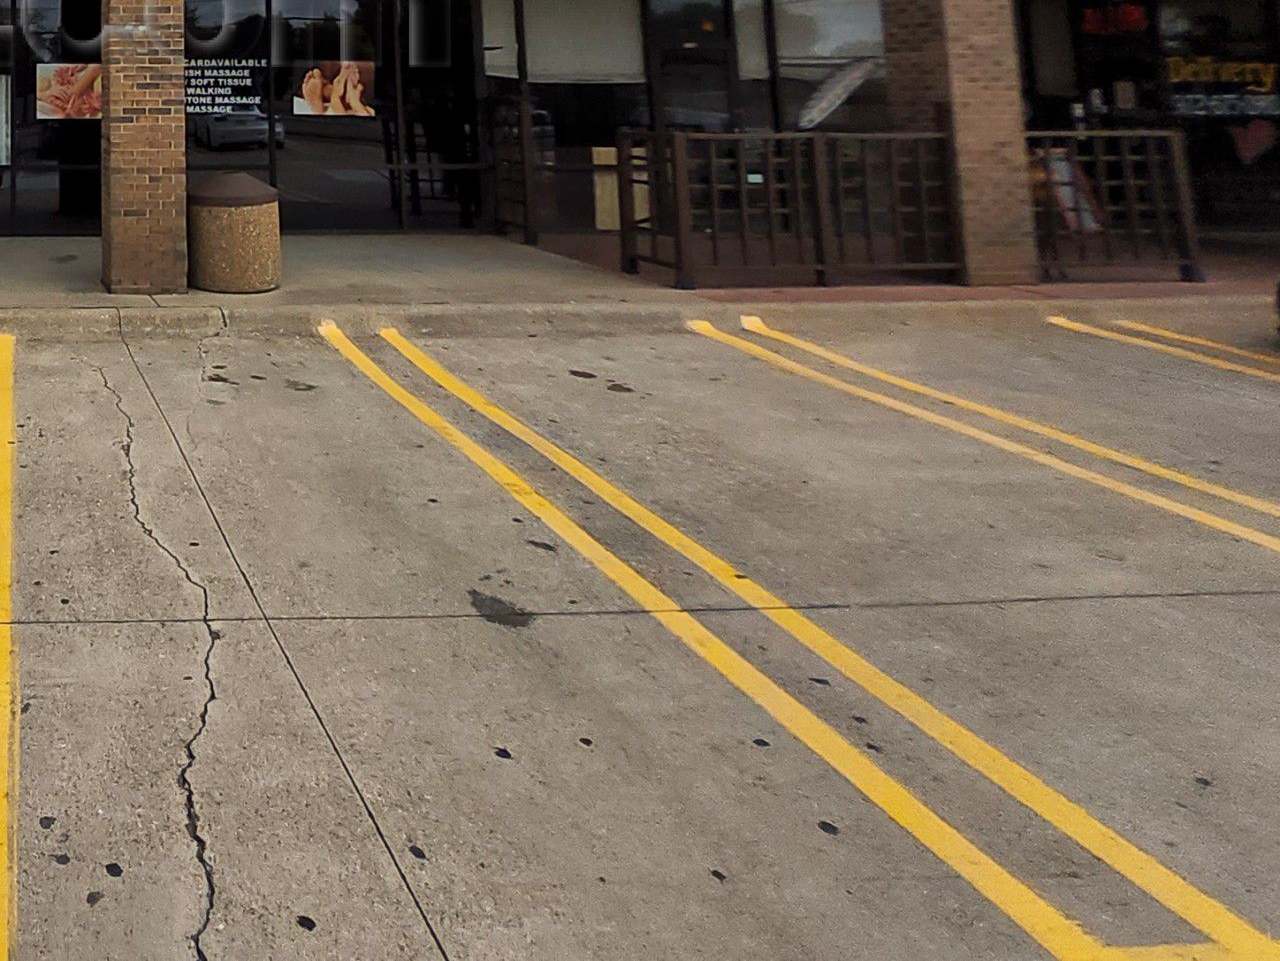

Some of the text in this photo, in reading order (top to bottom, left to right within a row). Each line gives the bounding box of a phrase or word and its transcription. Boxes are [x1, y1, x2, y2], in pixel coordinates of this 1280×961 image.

[204, 69, 250, 77] MASSAGE
[190, 78, 215, 86] SOFT
[217, 78, 253, 86] TISSUE
[186, 87, 232, 95] WALKING
[214, 96, 261, 104] MASSAGE
[186, 105, 233, 113] MASSAGE
